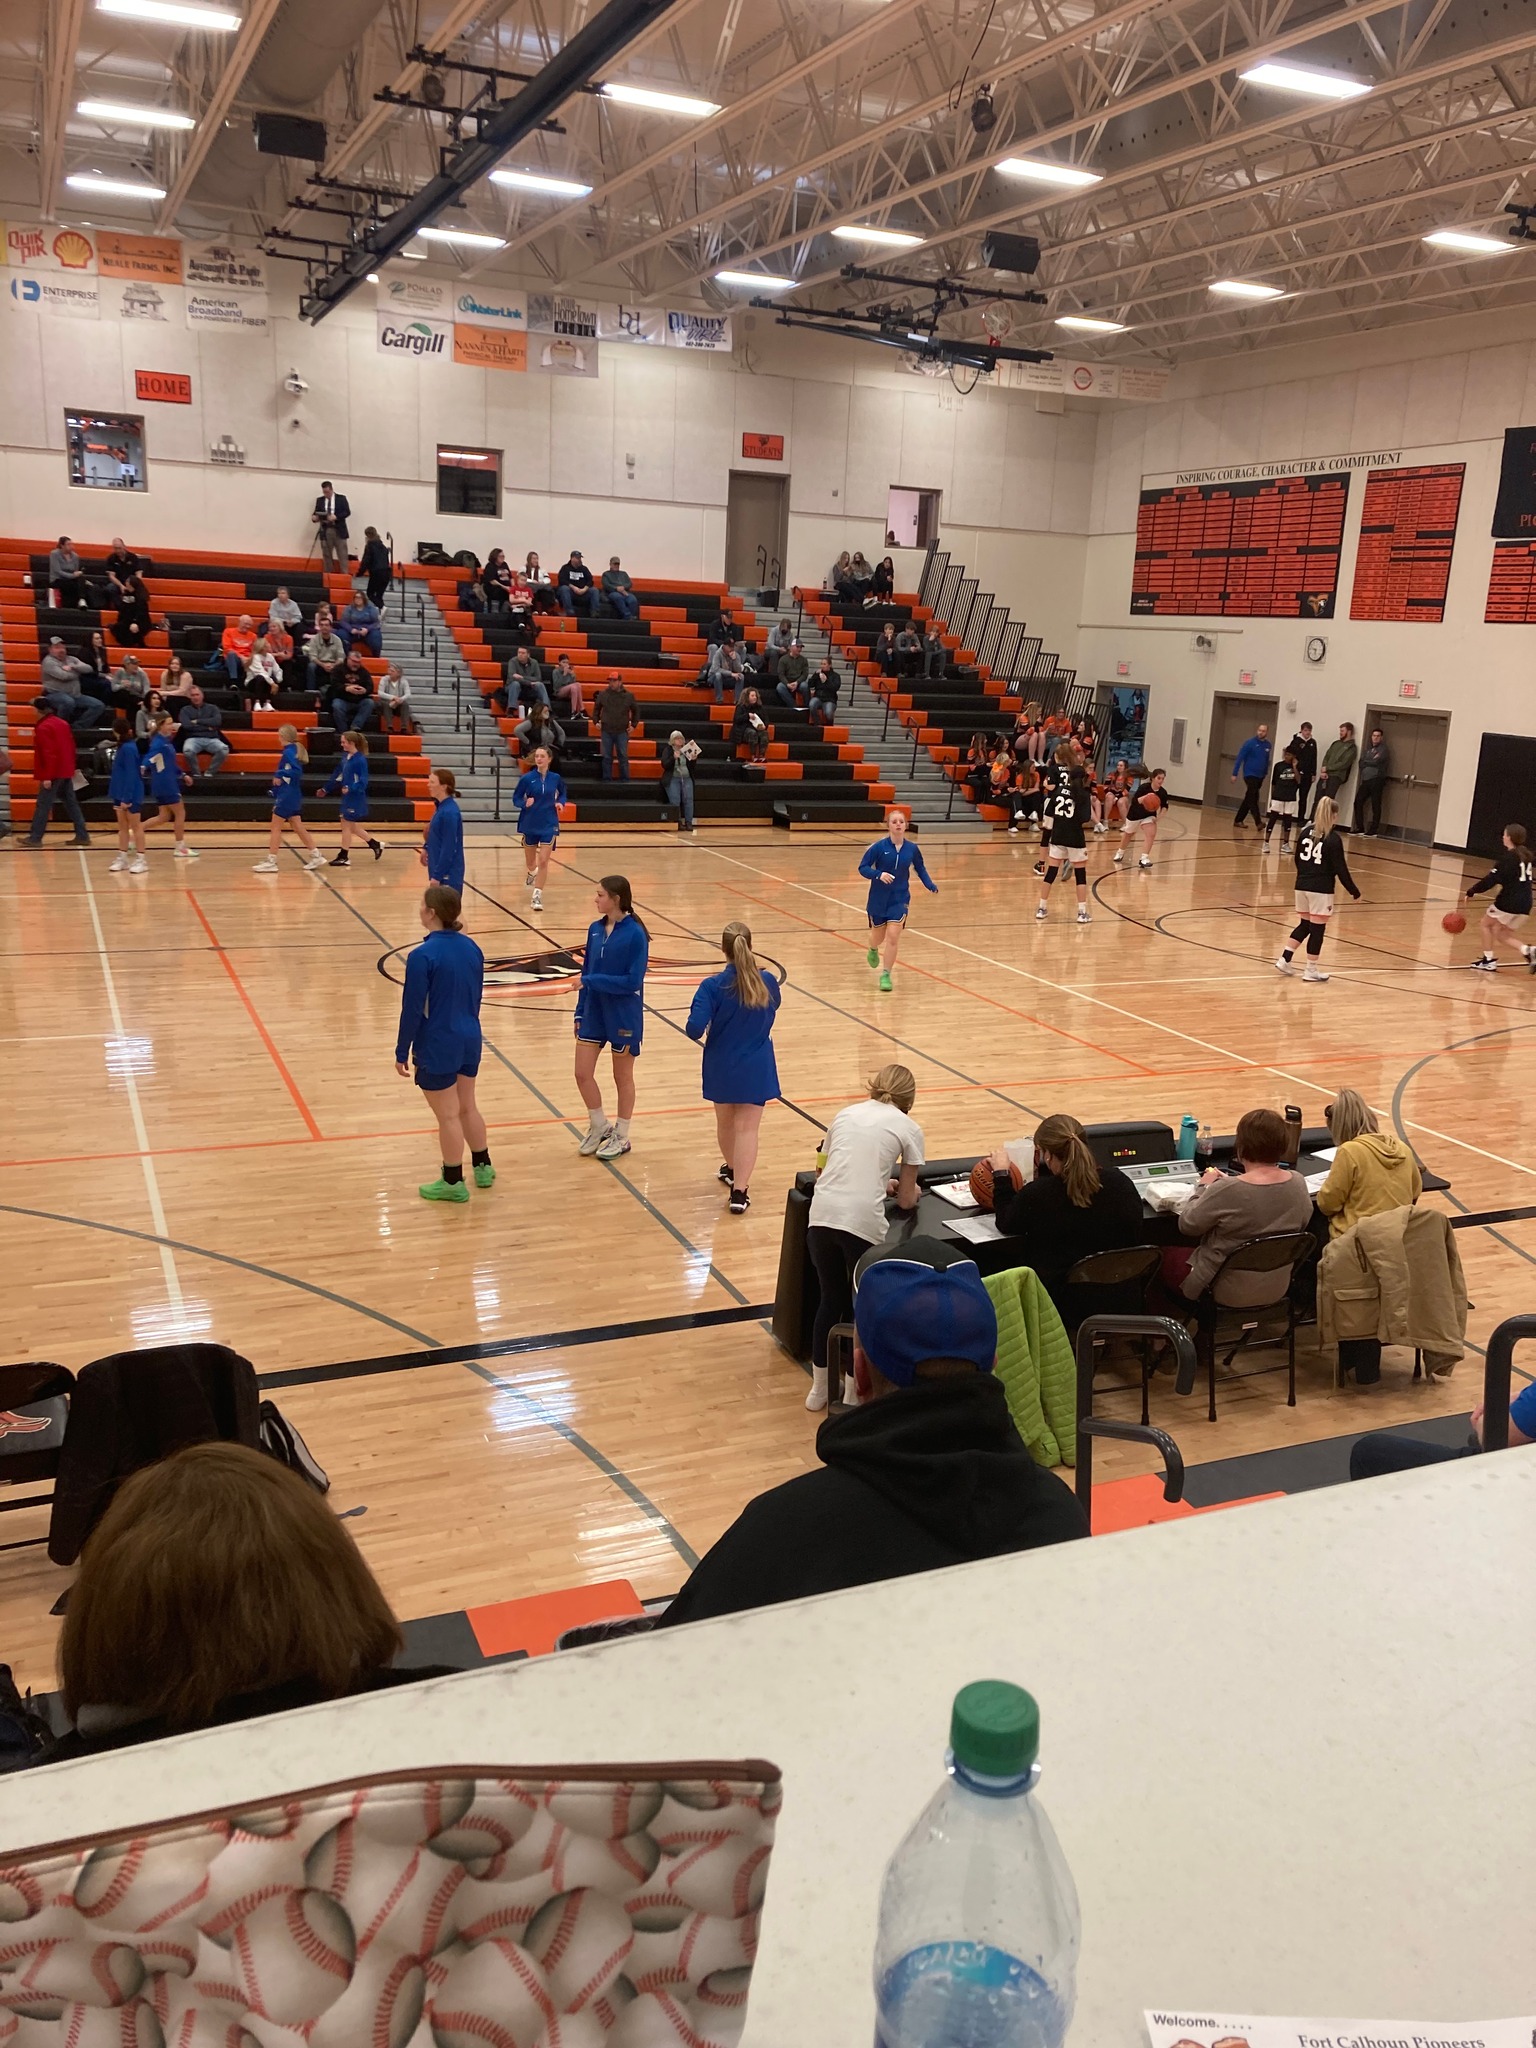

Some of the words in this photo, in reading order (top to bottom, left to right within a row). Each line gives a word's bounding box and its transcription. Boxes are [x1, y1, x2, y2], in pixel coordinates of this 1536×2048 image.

[43, 286, 98, 300] ENTERPRISE
[188, 305, 242, 317] Broadband
[191, 297, 238, 308] American
[242, 317, 267, 326] FIBER
[668, 312, 728, 333] QUALITY
[381, 327, 445, 355] Cargill
[138, 376, 189, 396] HOME
[744, 446, 782, 457] STUDENTS
[1176, 469, 1216, 484] INSPIRING
[1217, 466, 1260, 480] COURAGE,
[1261, 461, 1317, 476] CHARACTER
[1318, 460, 1326, 471] &
[1329, 452, 1403, 470] COMMITMENT
[1055, 796, 1075, 818] 23
[1300, 838, 1323, 864] 34
[1297, 2035, 1333, 2048] Fort
[1336, 2035, 1409, 2048] Calhoun
[1411, 2036, 1486, 2048] Pioneers
